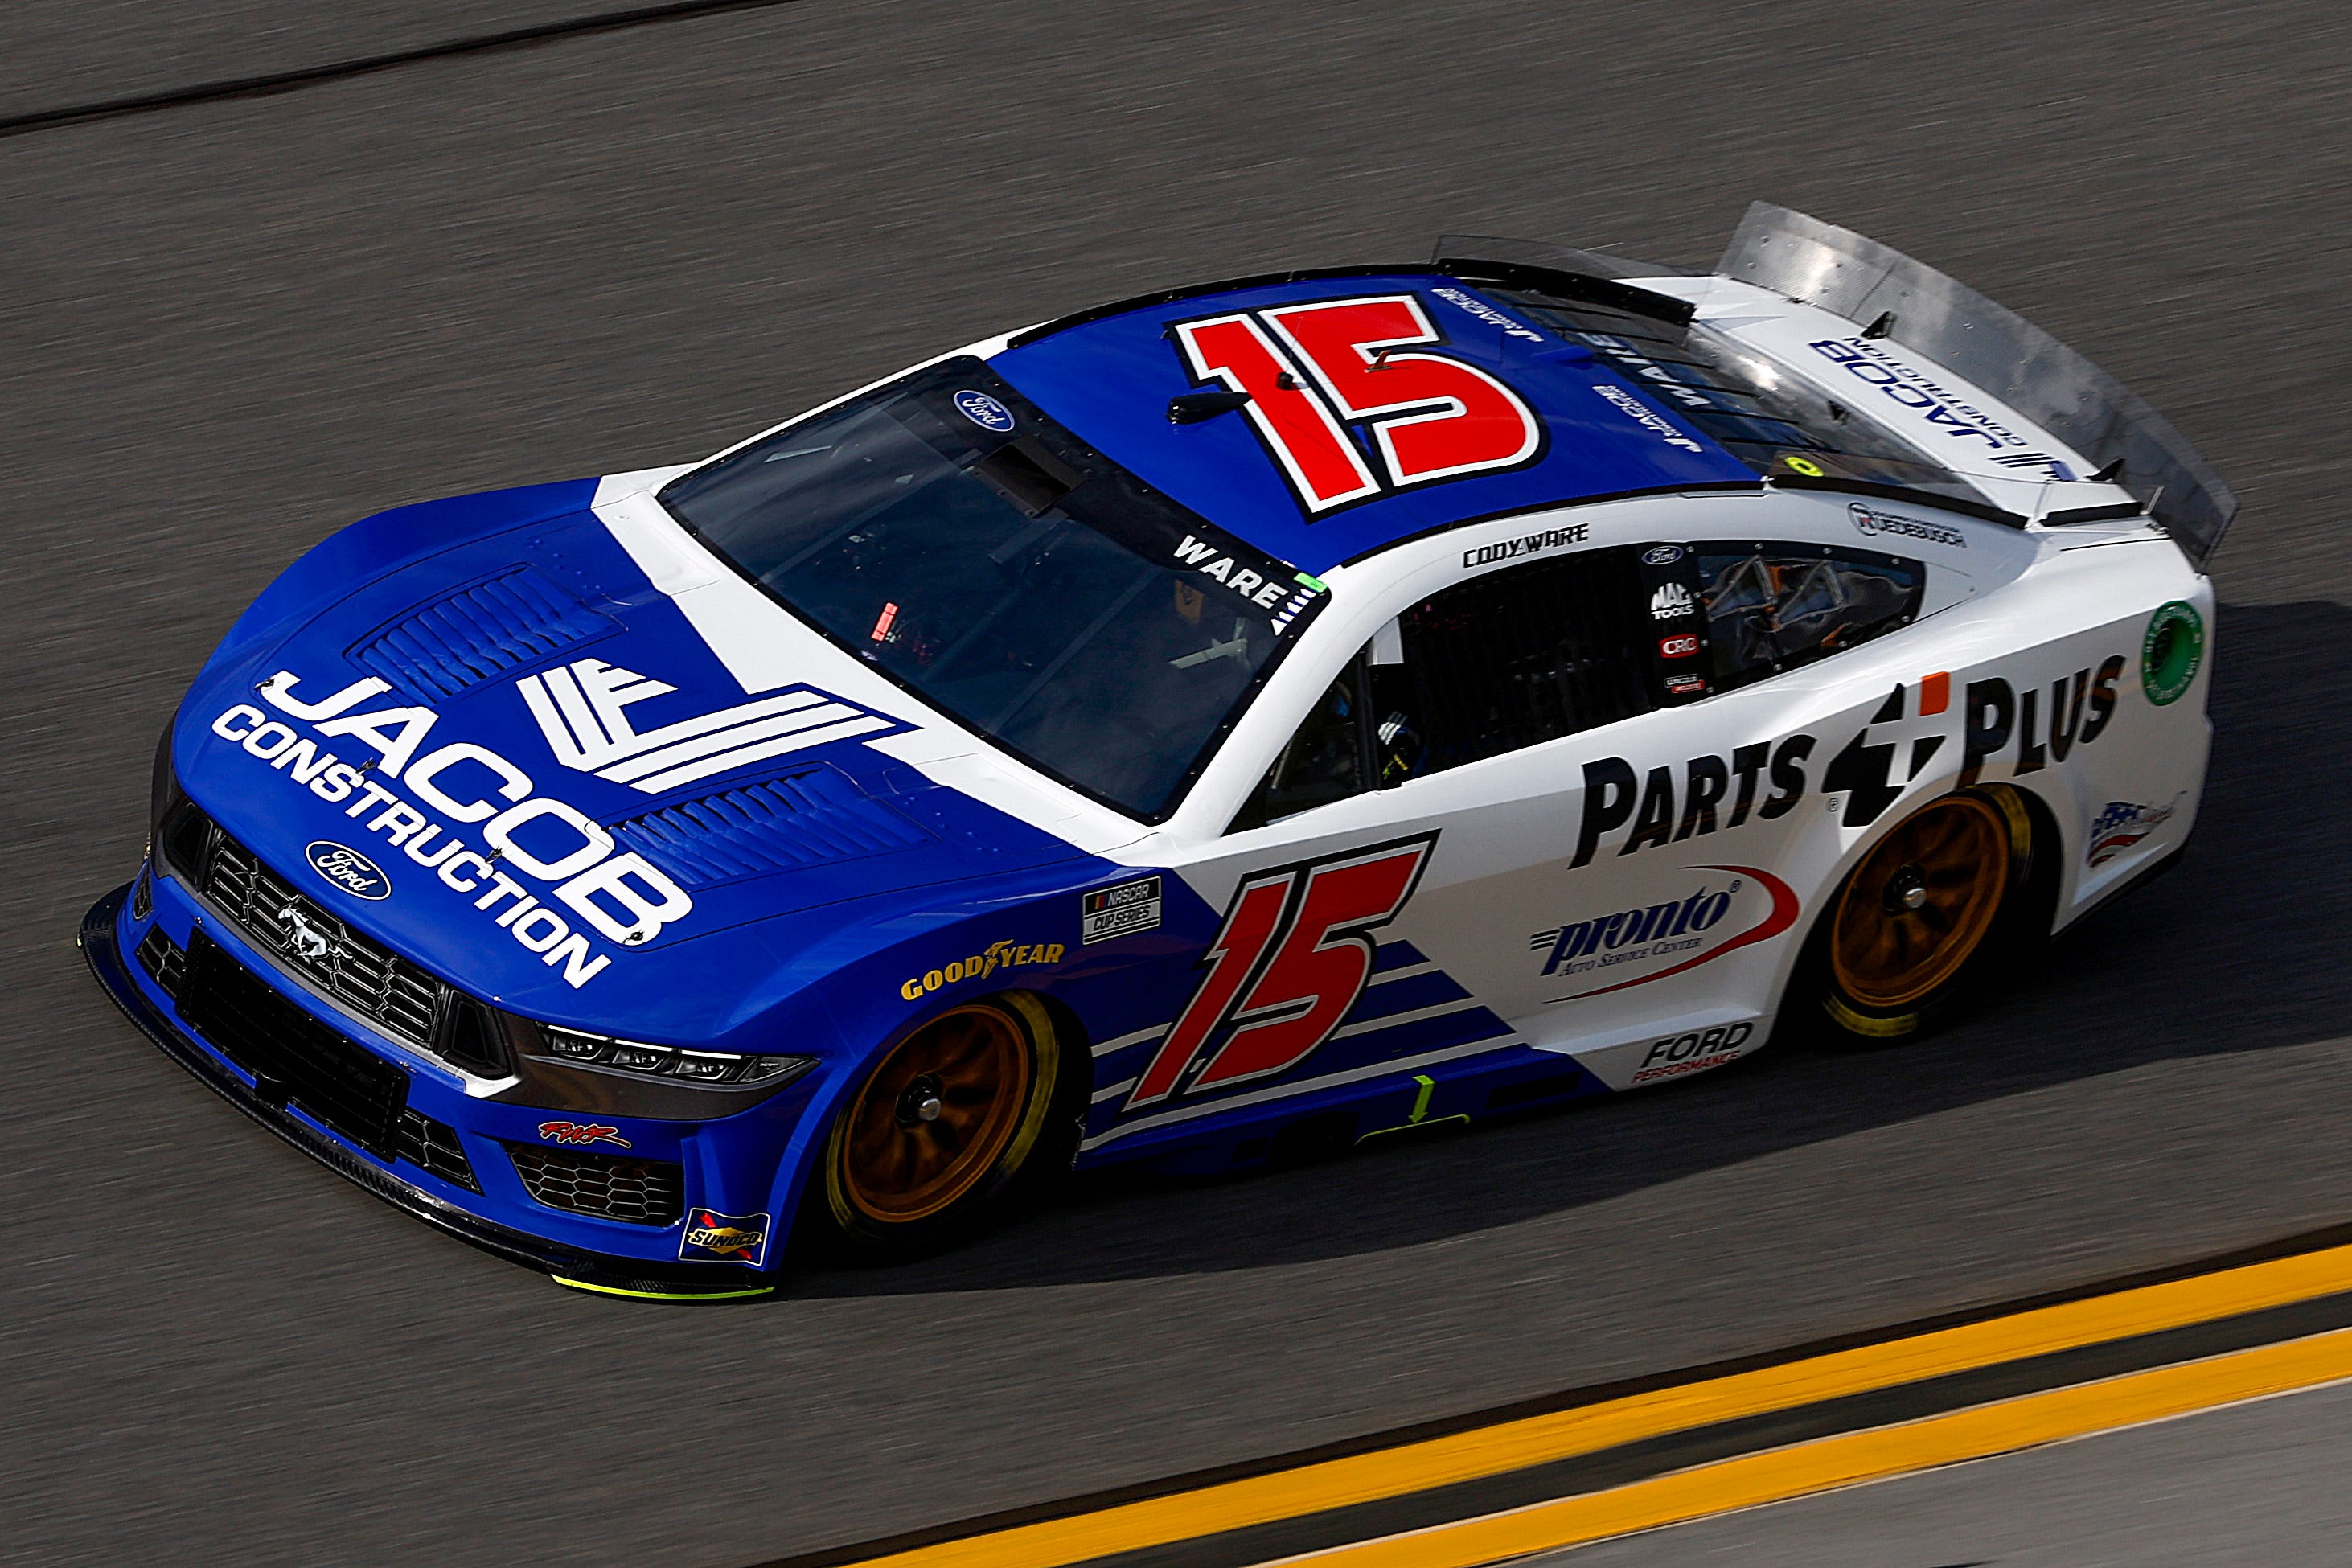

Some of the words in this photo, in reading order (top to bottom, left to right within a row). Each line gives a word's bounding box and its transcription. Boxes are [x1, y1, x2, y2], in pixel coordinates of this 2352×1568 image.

[962, 397, 1005, 425] Ford
[1173, 293, 1541, 514] 15
[1808, 339, 2004, 449] JACOB
[1463, 538, 1525, 568] CODY
[1523, 523, 1589, 553] WARE
[1173, 534, 1290, 610] WARE
[1651, 582, 1694, 610] MAC
[1651, 605, 1695, 620] TOOLS
[1663, 637, 1697, 655] CRC
[1568, 734, 1817, 870] PARTS
[1955, 655, 2128, 789] PLUS
[259, 670, 693, 946] JACOB
[212, 704, 612, 989] CONSTRUCTION
[317, 850, 378, 891] Ford
[1108, 884, 1150, 906] NASCAR
[1094, 913, 1115, 932] CUP
[1114, 905, 1151, 926] SERIES
[1541, 886, 1732, 976] pronto
[901, 940, 1065, 1002] GOODYEAR
[1122, 831, 1438, 1113] 15
[1631, 1050, 1742, 1084] PERFORMANCE
[1640, 1022, 1755, 1068] FORD
[692, 1229, 762, 1247] SUNOCO
